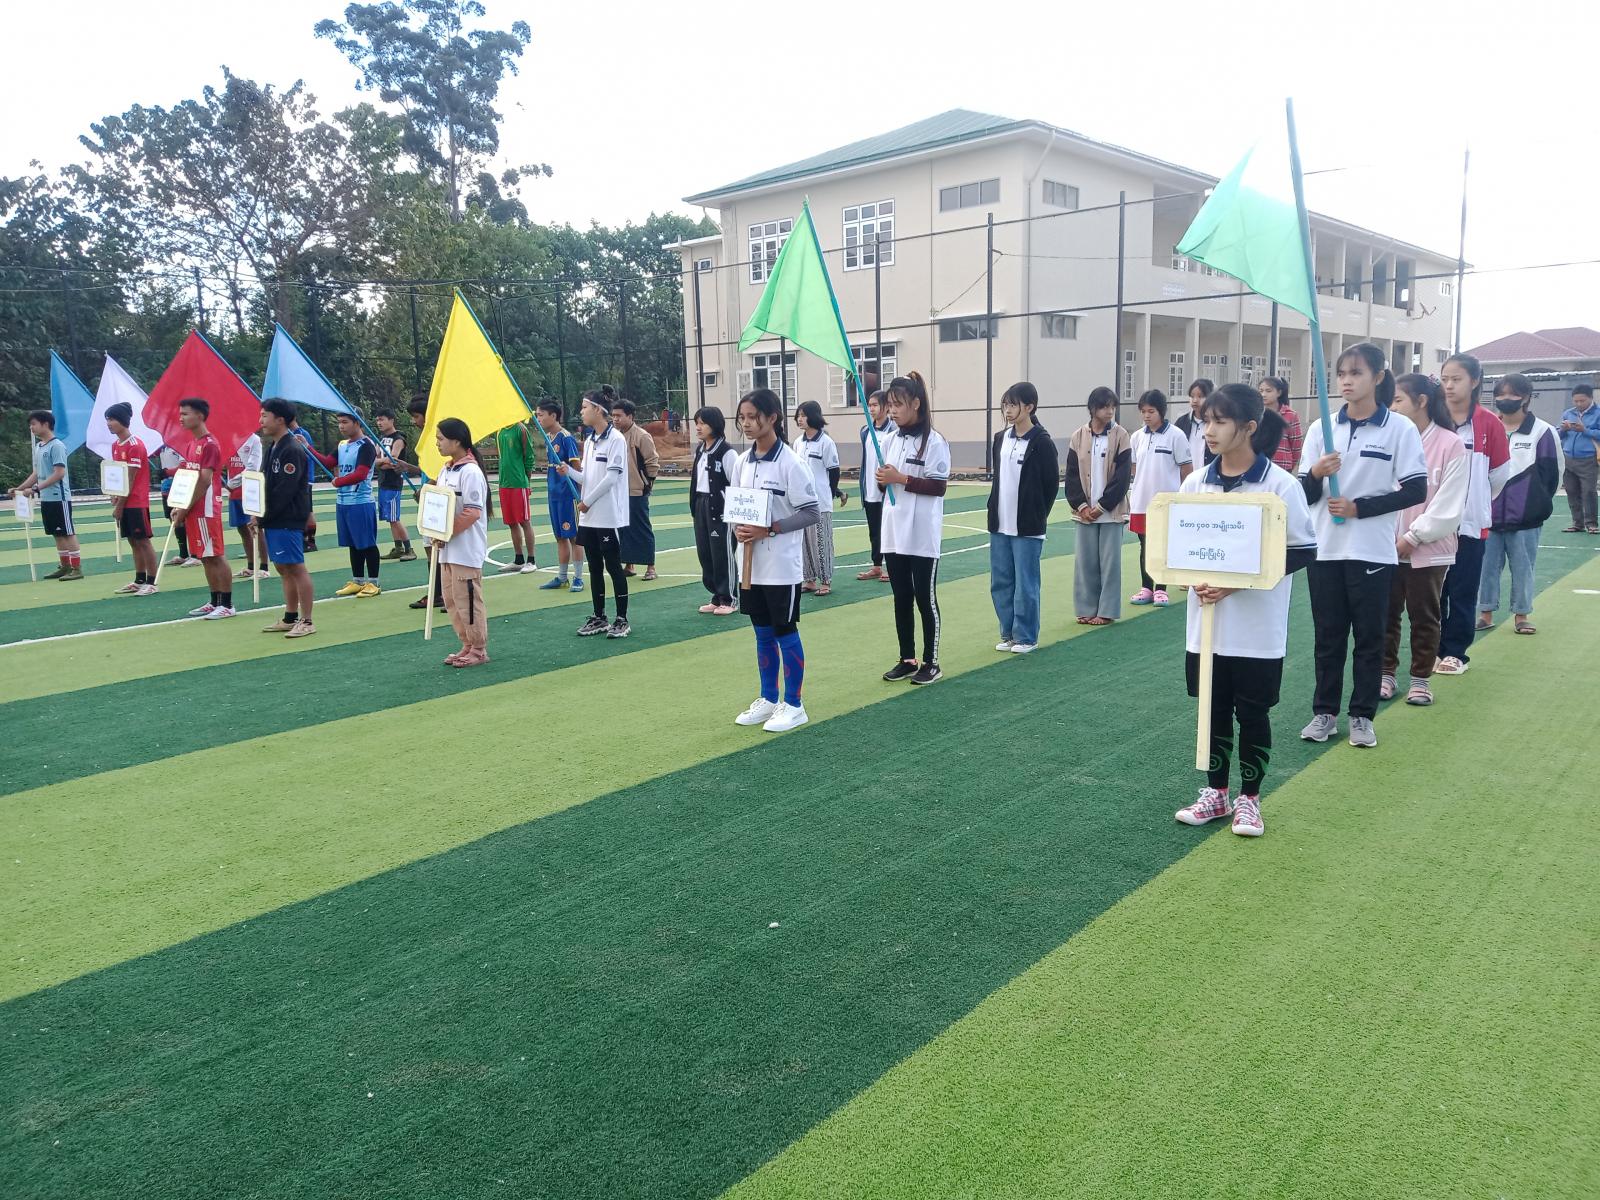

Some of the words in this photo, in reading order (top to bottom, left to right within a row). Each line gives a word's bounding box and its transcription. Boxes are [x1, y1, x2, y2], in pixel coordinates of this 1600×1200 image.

[715, 460, 722, 473] R
[1179, 519, 1195, 528] မီတာ
[1196, 522, 1210, 532] ၄၀၀
[1211, 520, 1244, 532] အမျိုးသမီး
[1188, 547, 1225, 560] အပြေးပြိုင်ပွဲ
